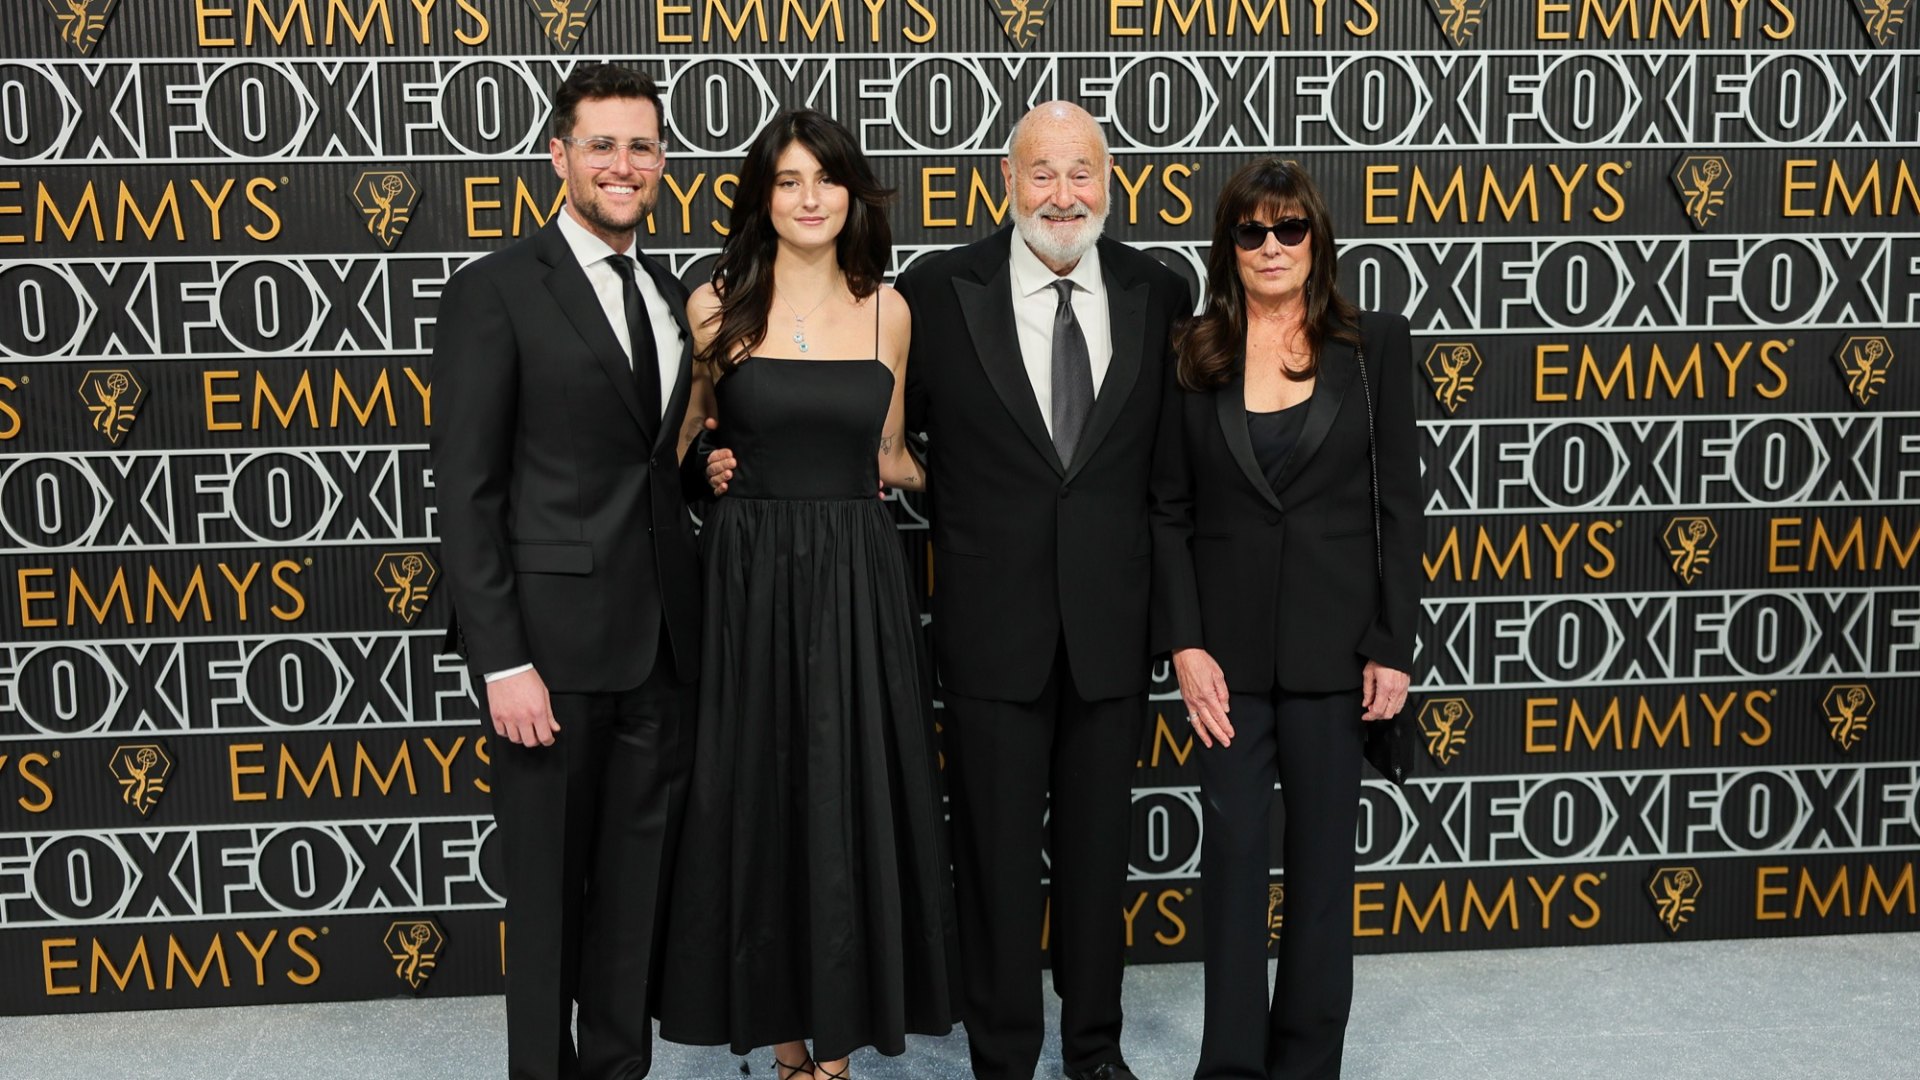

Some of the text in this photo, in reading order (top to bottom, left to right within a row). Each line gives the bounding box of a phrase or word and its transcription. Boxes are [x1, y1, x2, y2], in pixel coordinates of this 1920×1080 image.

[195, 0, 491, 47] EMMYS
[656, 0, 938, 43] EMMYS
[1109, 0, 1379, 38] EMMYS
[1537, 0, 1797, 40] EMMYS
[0, 57, 147, 165] OX
[134, 55, 382, 164] FOX
[1270, 50, 1488, 151] FOX
[1483, 50, 1696, 149] FOX
[1691, 49, 1901, 148] FOX
[922, 162, 1194, 227] EMYS
[0, 257, 162, 363] OX
[148, 254, 393, 360] FOX
[1473, 235, 1690, 335] FOX
[1681, 232, 1892, 332] FOX
[203, 368, 432, 431] EMMY
[0, 452, 176, 554] OX
[164, 446, 404, 549] FOX
[1470, 417, 1684, 514] FOX
[1674, 412, 1883, 510] FOX
[1422, 520, 1616, 582] MMYS
[1768, 516, 1920, 574] EMM
[180, 632, 414, 735] FOX
[1468, 590, 1677, 691] FOX
[1664, 587, 1874, 684] FOX
[190, 820, 424, 924] FOX
[1463, 769, 1671, 867] FOX
[1661, 764, 1866, 861] FOX
[1756, 862, 1920, 920] EMM
